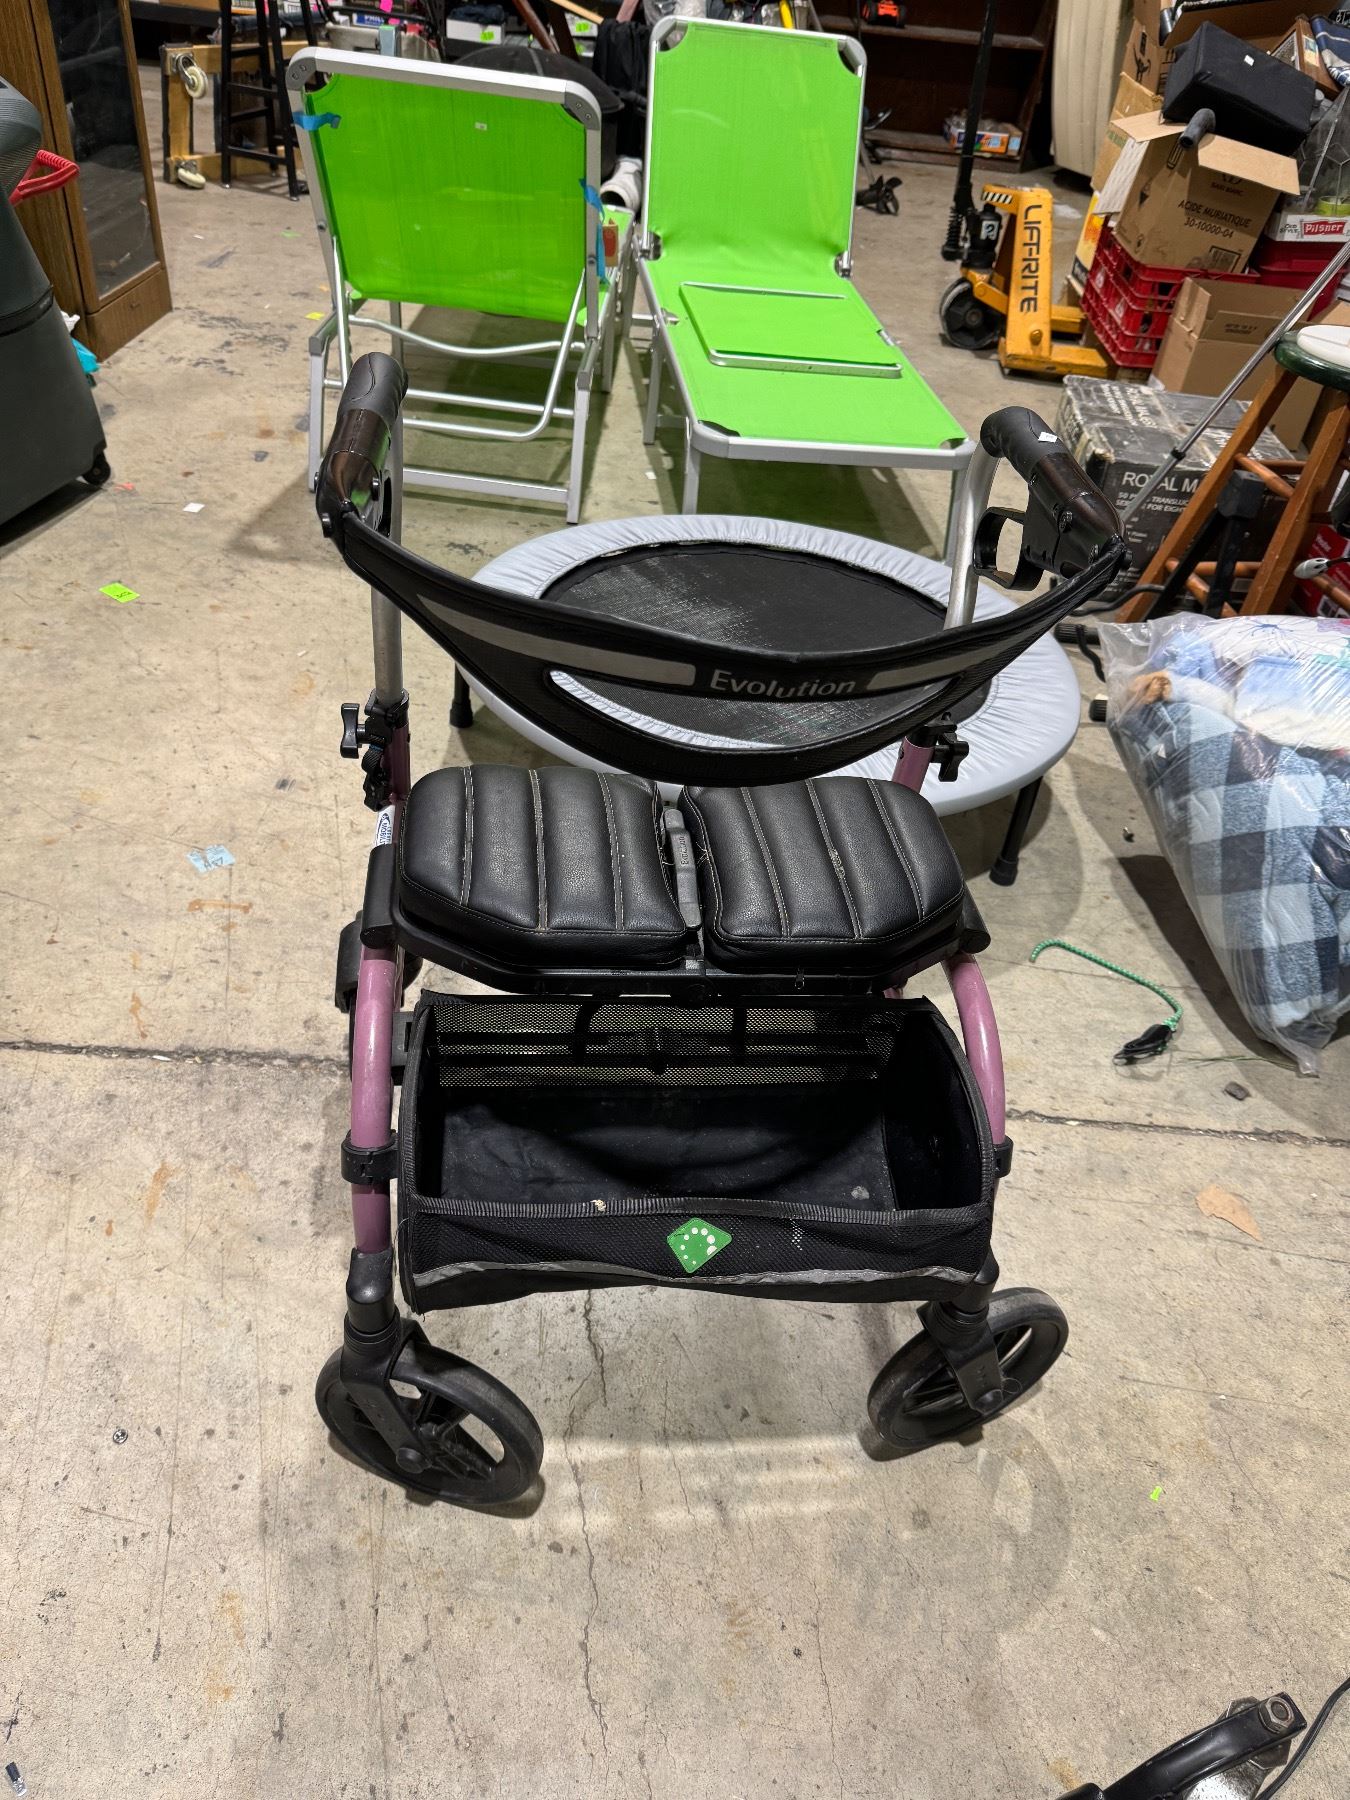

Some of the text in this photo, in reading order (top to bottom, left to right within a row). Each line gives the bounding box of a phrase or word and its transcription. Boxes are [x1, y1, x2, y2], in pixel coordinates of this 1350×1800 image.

[1178, 200, 1203, 214] ACIDE
[1304, 223, 1344, 233] Pilsner
[1020, 204, 1042, 312] LIFT-RITE
[1121, 471, 1179, 492] ROAL
[710, 668, 856, 699] Evolution
